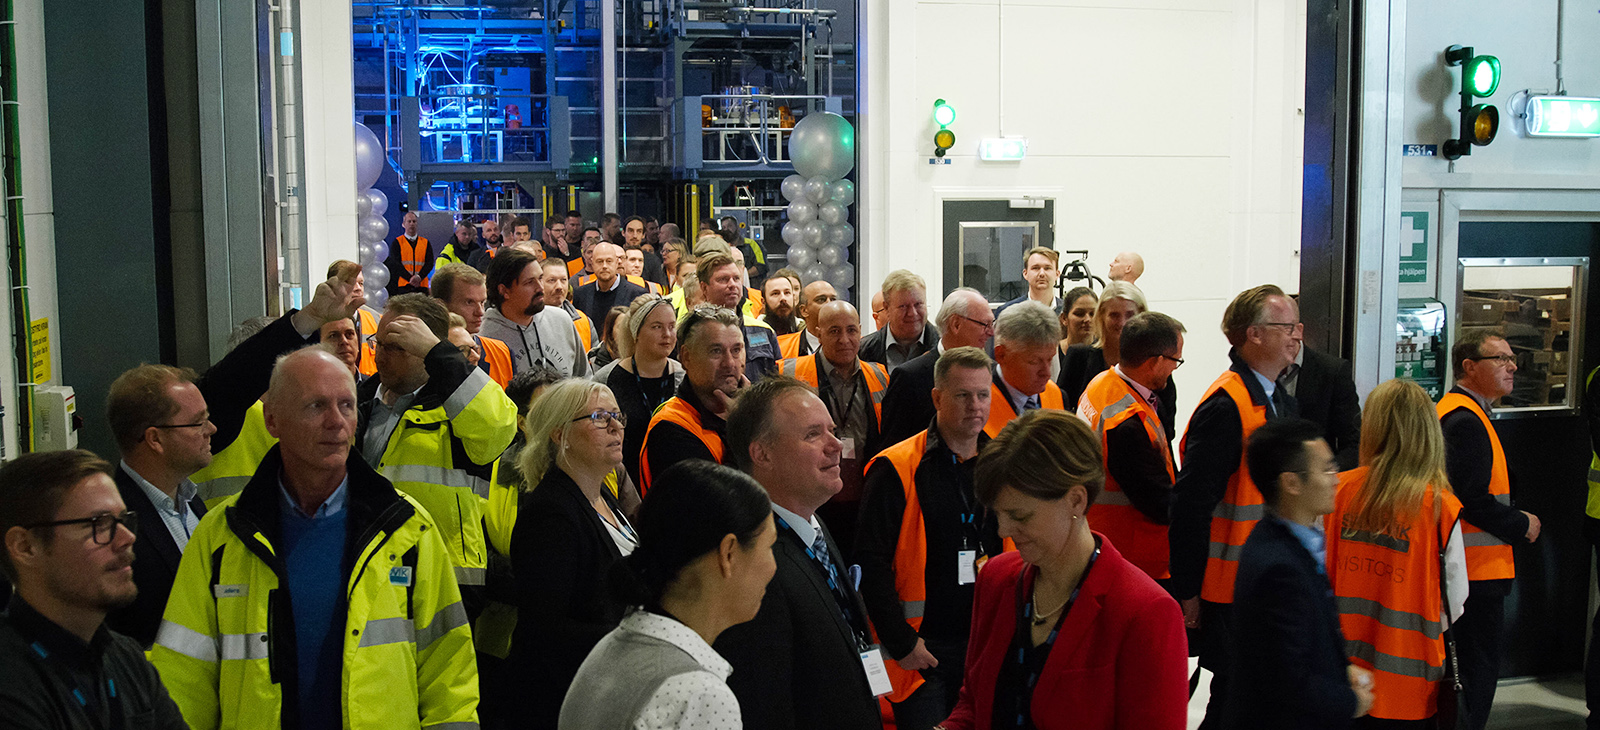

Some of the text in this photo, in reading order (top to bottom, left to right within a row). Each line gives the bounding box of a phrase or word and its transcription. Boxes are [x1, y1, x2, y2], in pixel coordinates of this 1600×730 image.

[1408, 145, 1426, 156] 531
[514, 341, 541, 361] BRND
[544, 344, 564, 363] WITH
